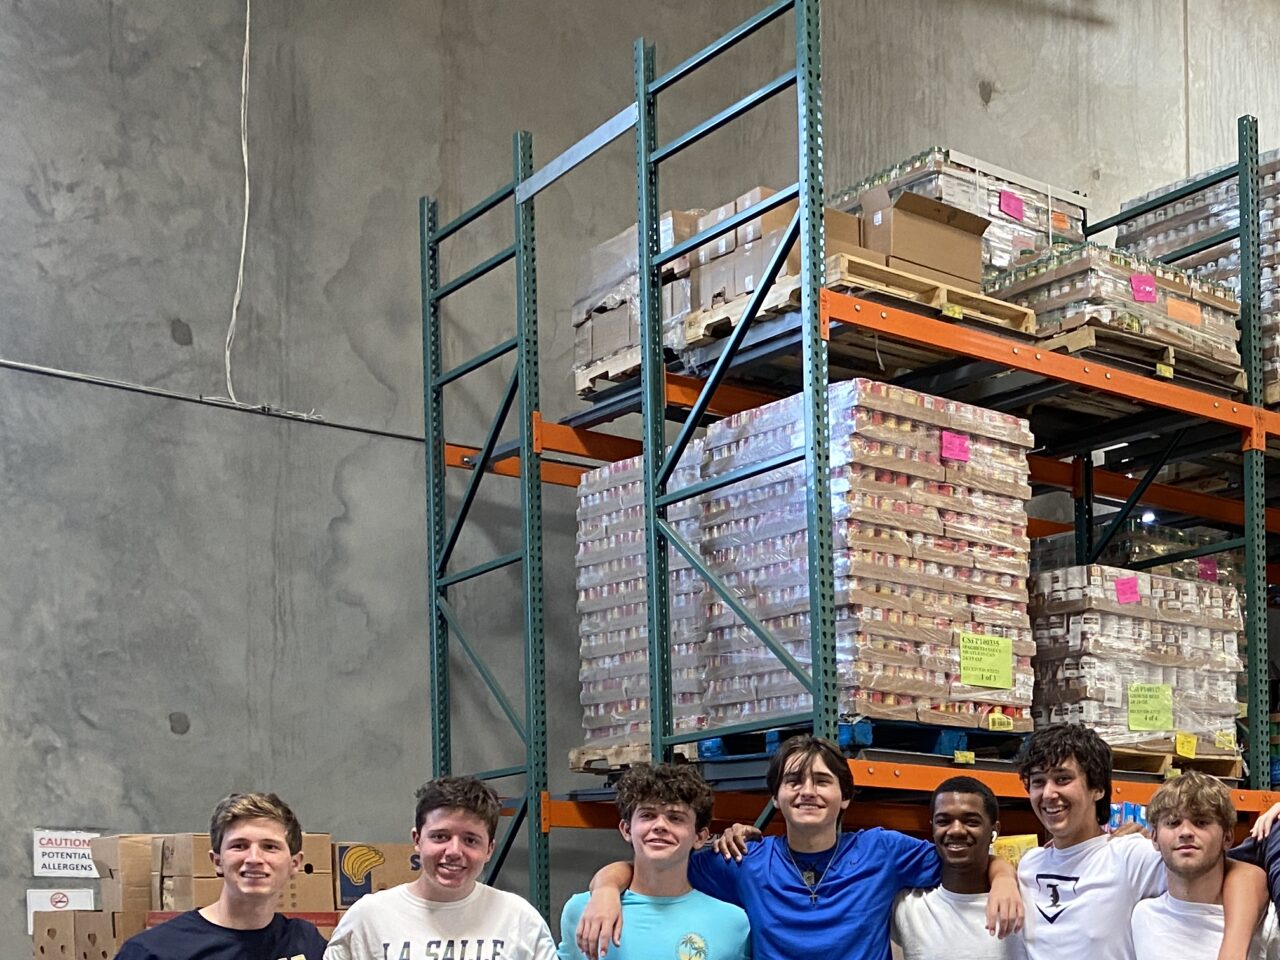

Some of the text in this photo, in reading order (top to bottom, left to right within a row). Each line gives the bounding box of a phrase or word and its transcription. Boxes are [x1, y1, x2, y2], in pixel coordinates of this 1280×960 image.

[39, 838, 91, 848] CAUTION
[42, 851, 92, 860] POTENTIAL
[41, 863, 93, 871] ALLERGENS
